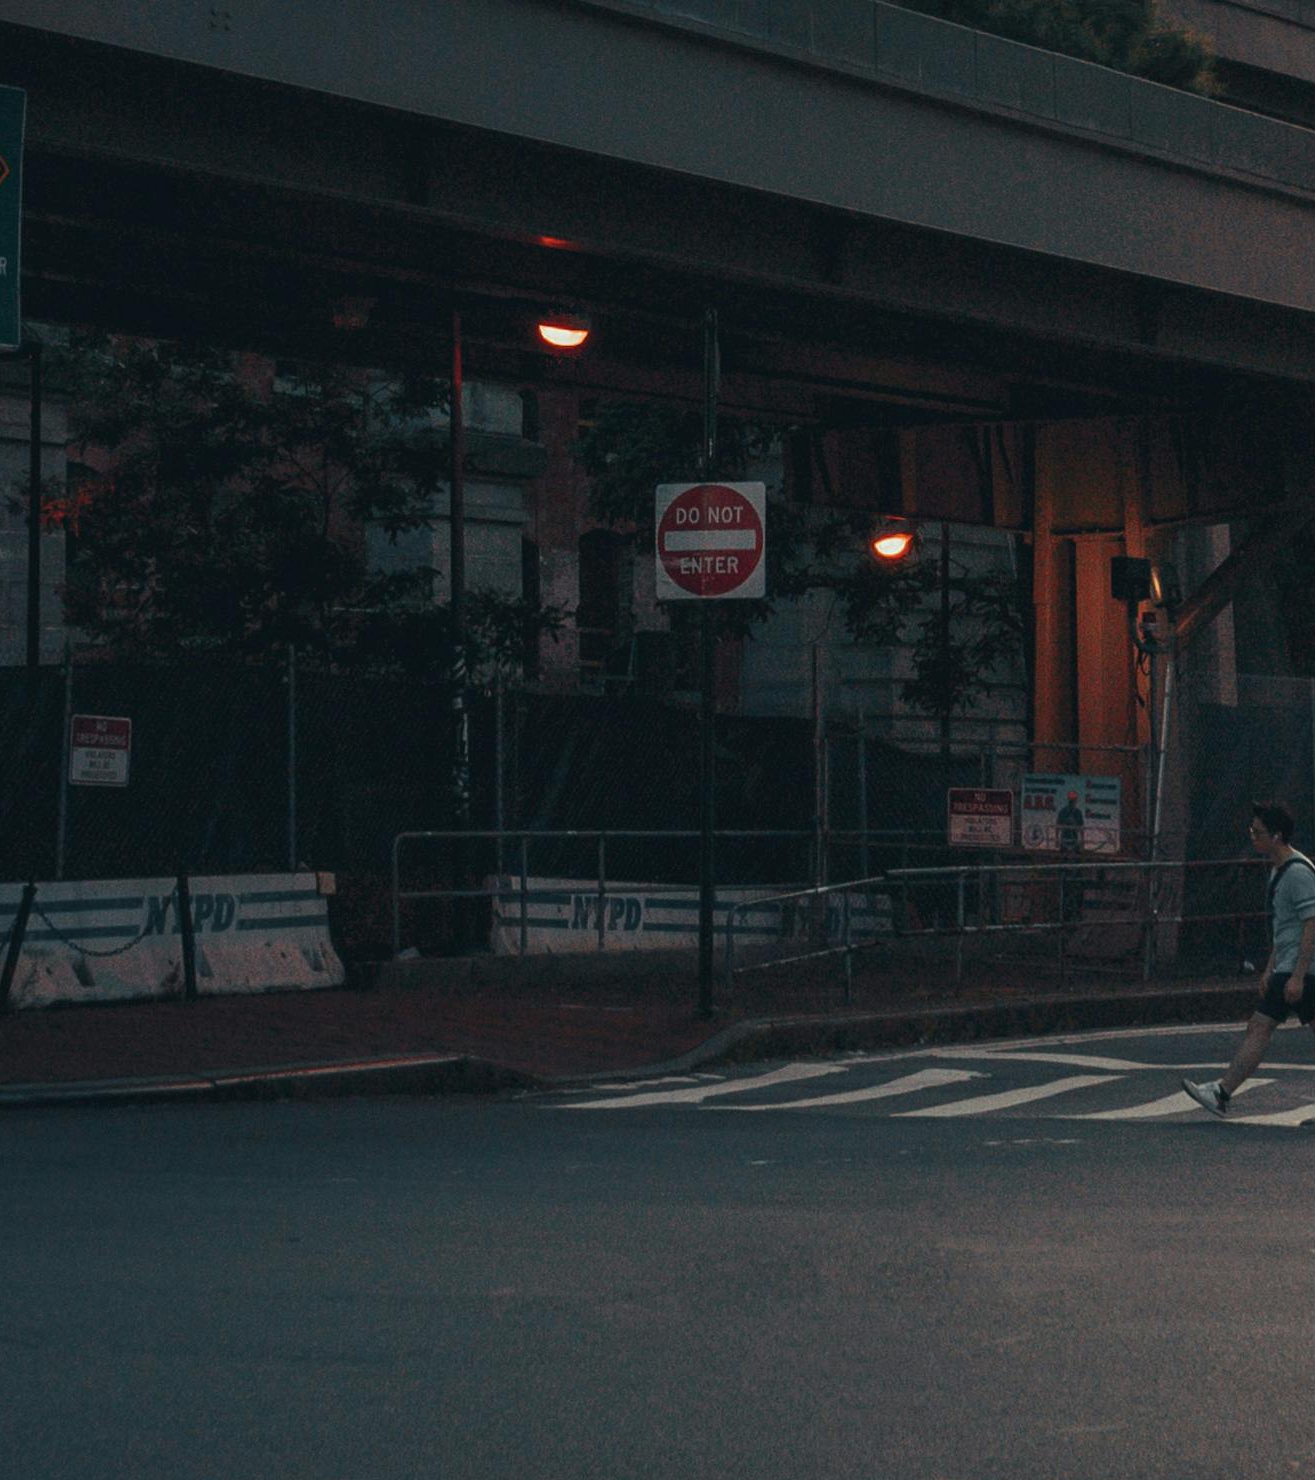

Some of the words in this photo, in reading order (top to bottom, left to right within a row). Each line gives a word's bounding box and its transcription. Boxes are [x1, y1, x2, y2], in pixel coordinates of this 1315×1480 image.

[676, 507, 700, 525] DO
[708, 505, 744, 524] NOT
[680, 555, 739, 575] ENTER
